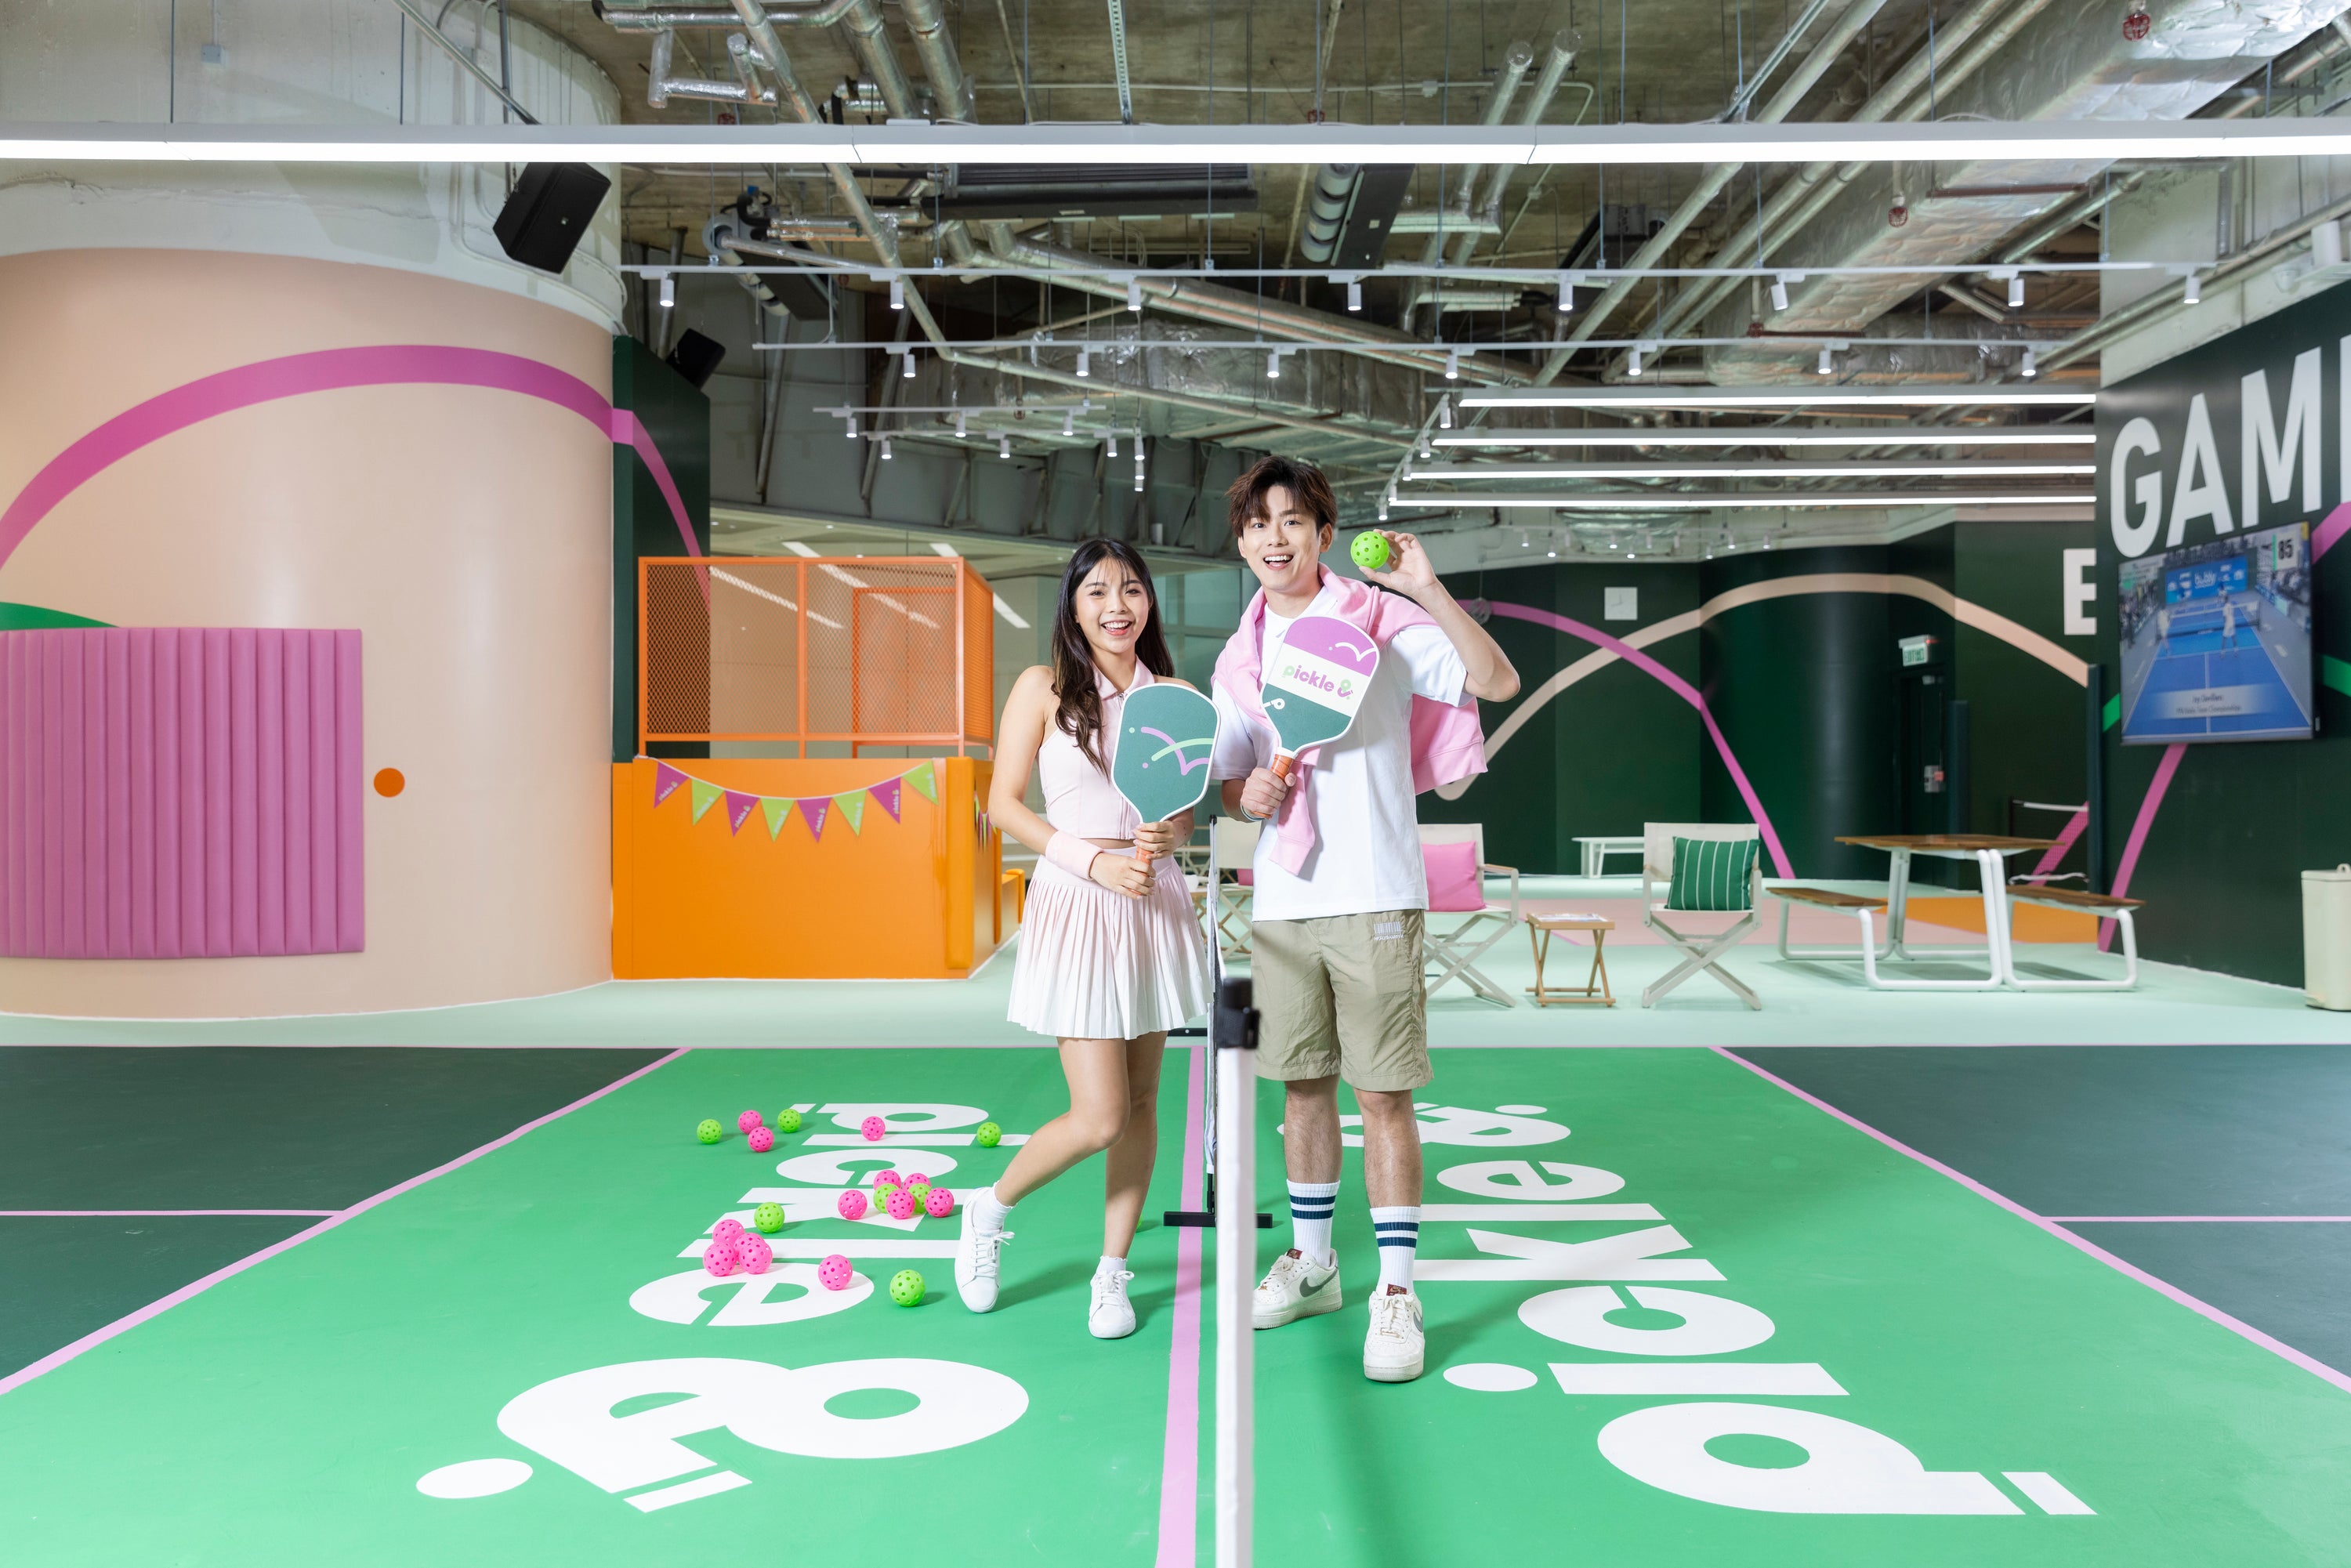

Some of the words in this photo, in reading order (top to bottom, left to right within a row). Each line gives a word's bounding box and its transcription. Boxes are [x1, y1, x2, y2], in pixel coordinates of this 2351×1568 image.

[1281, 664, 1335, 692] pickle
[629, 1103, 1032, 1326] pickle
[1413, 1161, 2097, 1515] pickle
